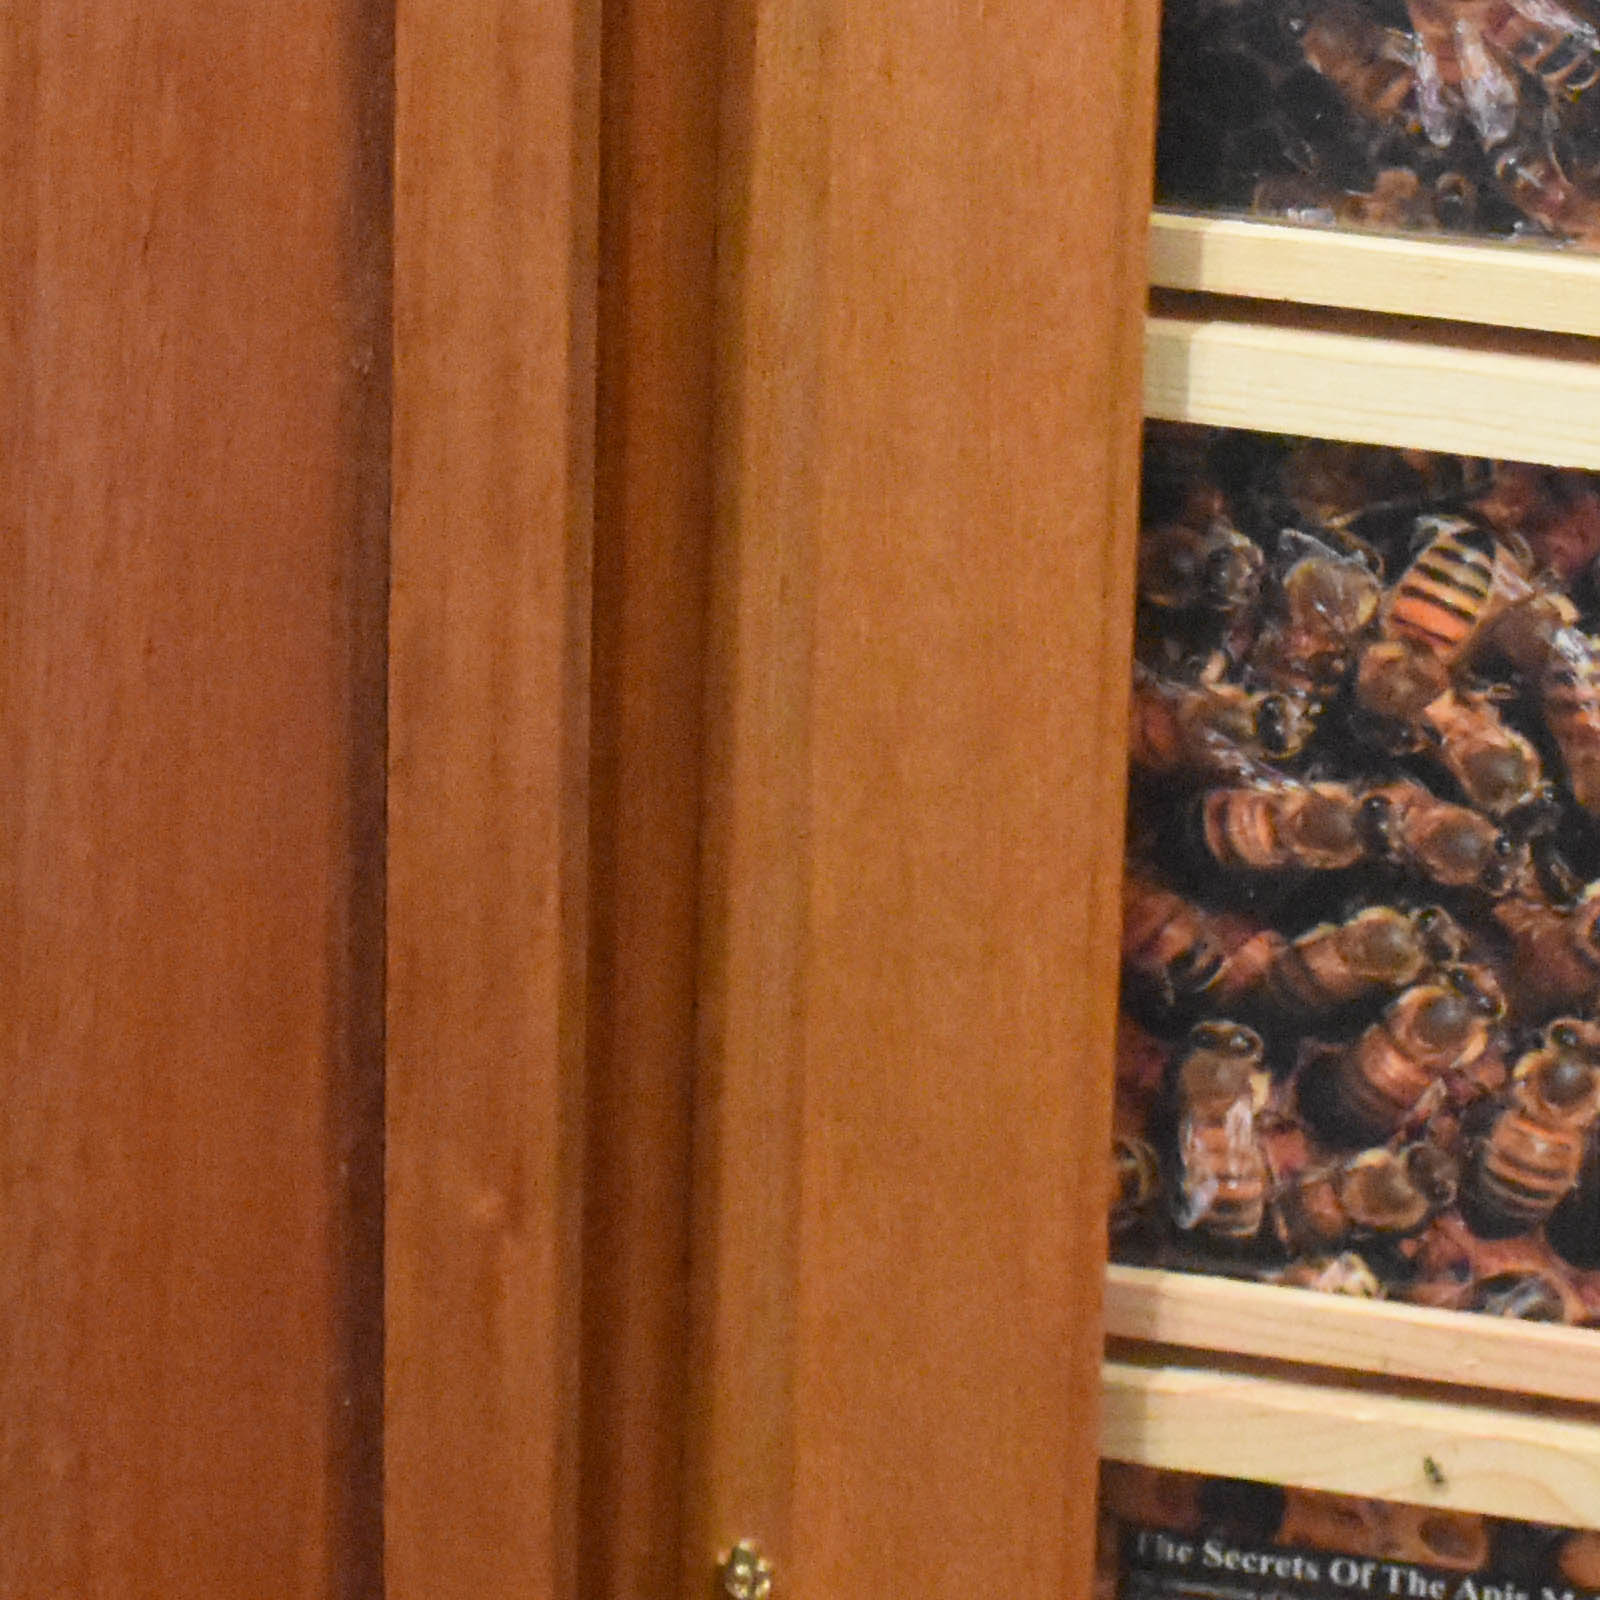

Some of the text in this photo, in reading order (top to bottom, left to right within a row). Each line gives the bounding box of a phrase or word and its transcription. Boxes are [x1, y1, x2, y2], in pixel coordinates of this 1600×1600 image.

[1203, 1539, 1319, 1581] Secrets
[1330, 1557, 1377, 1590] Of
[1384, 1562, 1447, 1600] The
